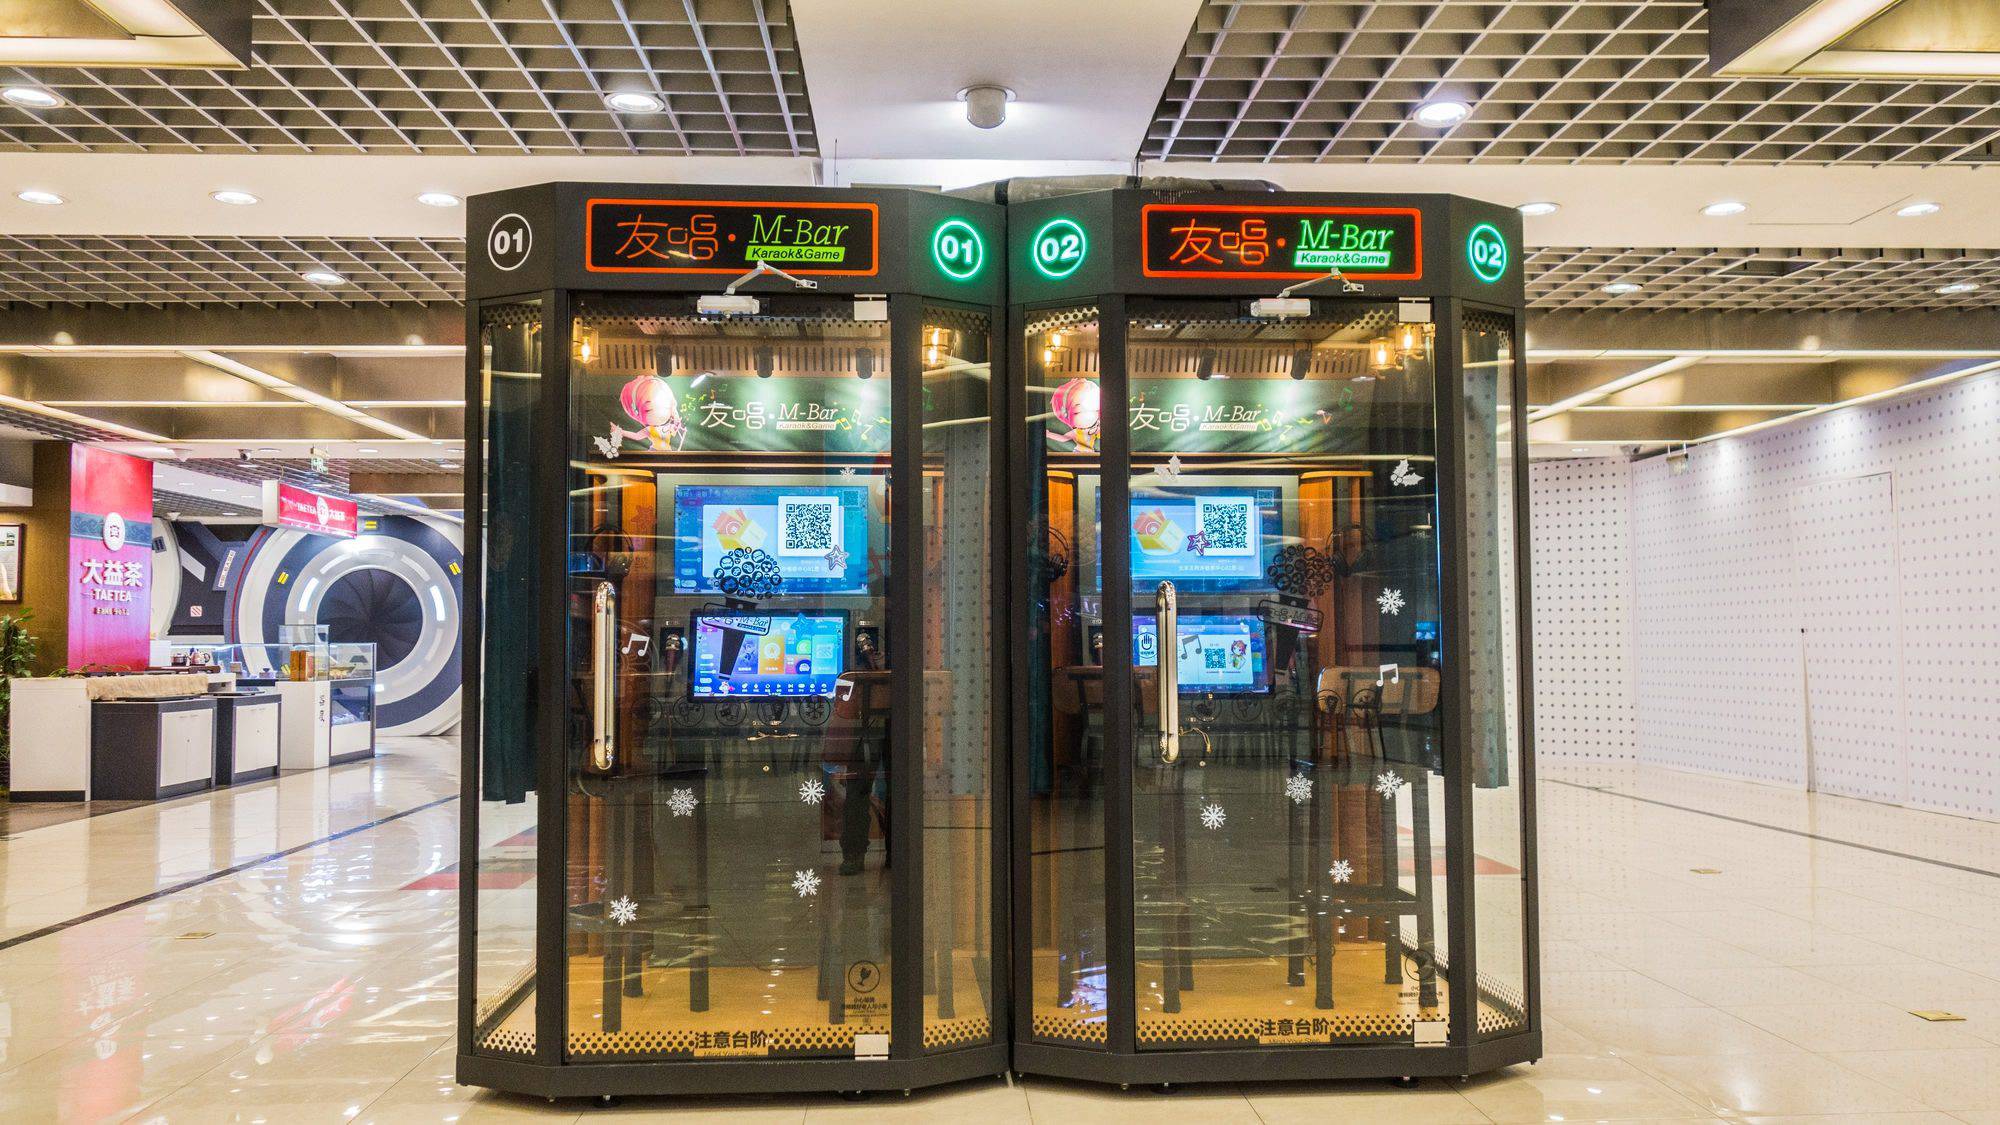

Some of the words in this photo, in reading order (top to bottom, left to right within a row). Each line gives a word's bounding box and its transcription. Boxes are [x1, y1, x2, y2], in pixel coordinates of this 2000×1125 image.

[493, 228, 525, 254] 01
[615, 213, 719, 261] 友唱
[748, 213, 849, 245] M-Bar
[1039, 235, 1081, 261] 02
[1169, 217, 1269, 266] 友唱
[1297, 218, 1395, 250] M-Bar
[751, 247, 841, 262] Karaok&Game
[939, 239, 975, 265] 01
[1301, 252, 1387, 265] Karaok&Game
[1473, 240, 1503, 268] 02
[700, 400, 766, 430] 友唱
[778, 402, 838, 420] M-Bar
[1129, 402, 1190, 432] 友唱
[1202, 405, 1262, 422] M-Bar
[81, 558, 143, 587] 大益茶
[93, 588, 132, 602] TAETEA
[695, 1030, 768, 1049] 注意台阶
[1259, 1018, 1330, 1036] 注意台阶
